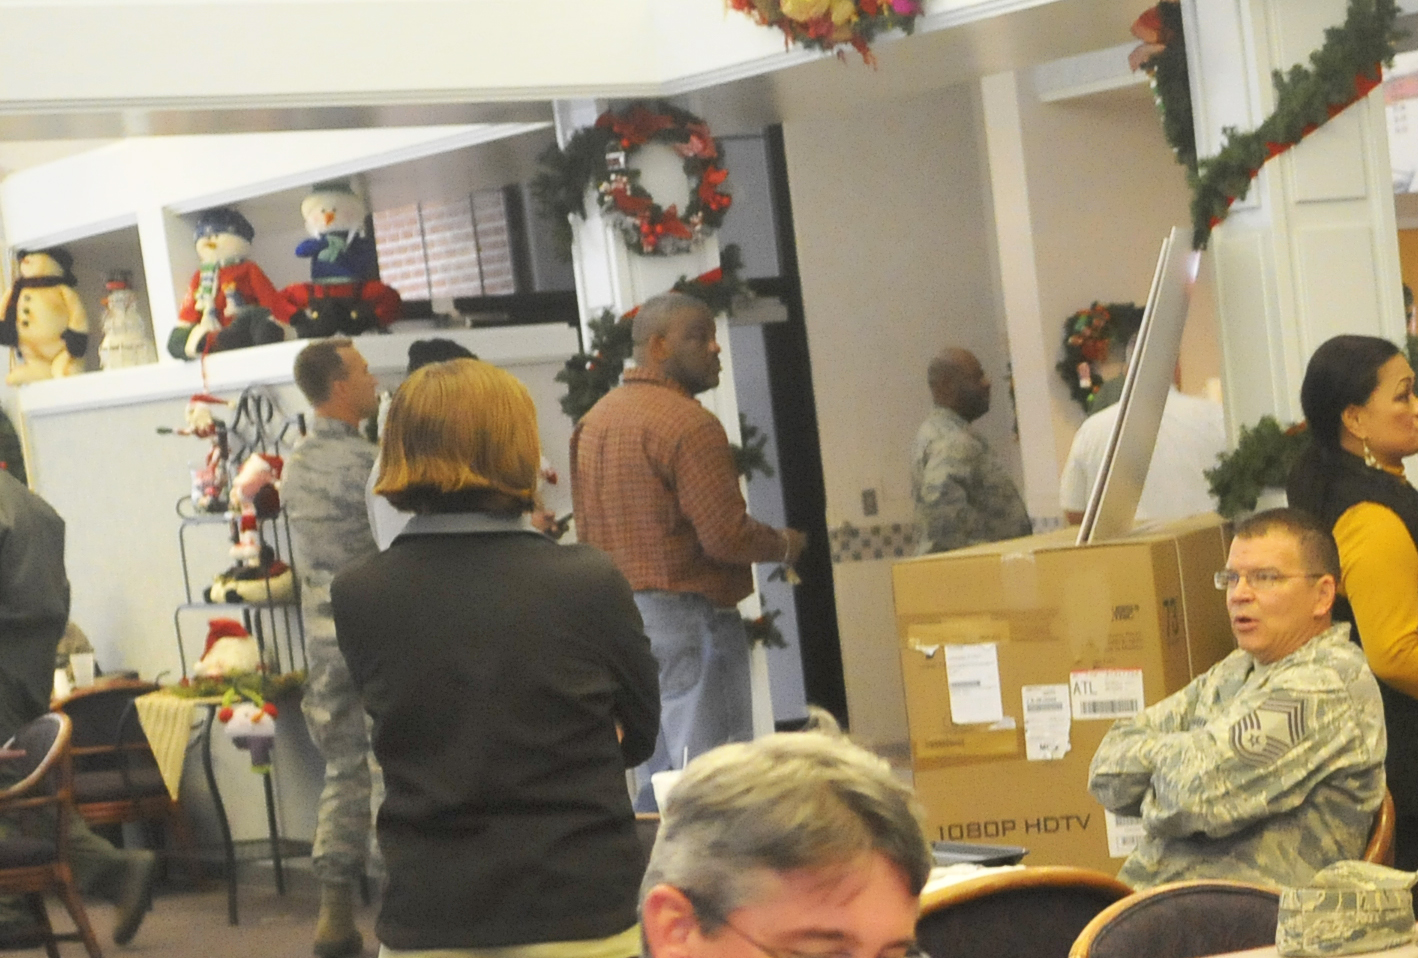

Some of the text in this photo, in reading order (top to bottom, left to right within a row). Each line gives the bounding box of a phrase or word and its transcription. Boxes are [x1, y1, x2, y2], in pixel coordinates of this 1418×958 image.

[1073, 681, 1097, 696] ATL
[938, 813, 1091, 841] 1080P HDTV
